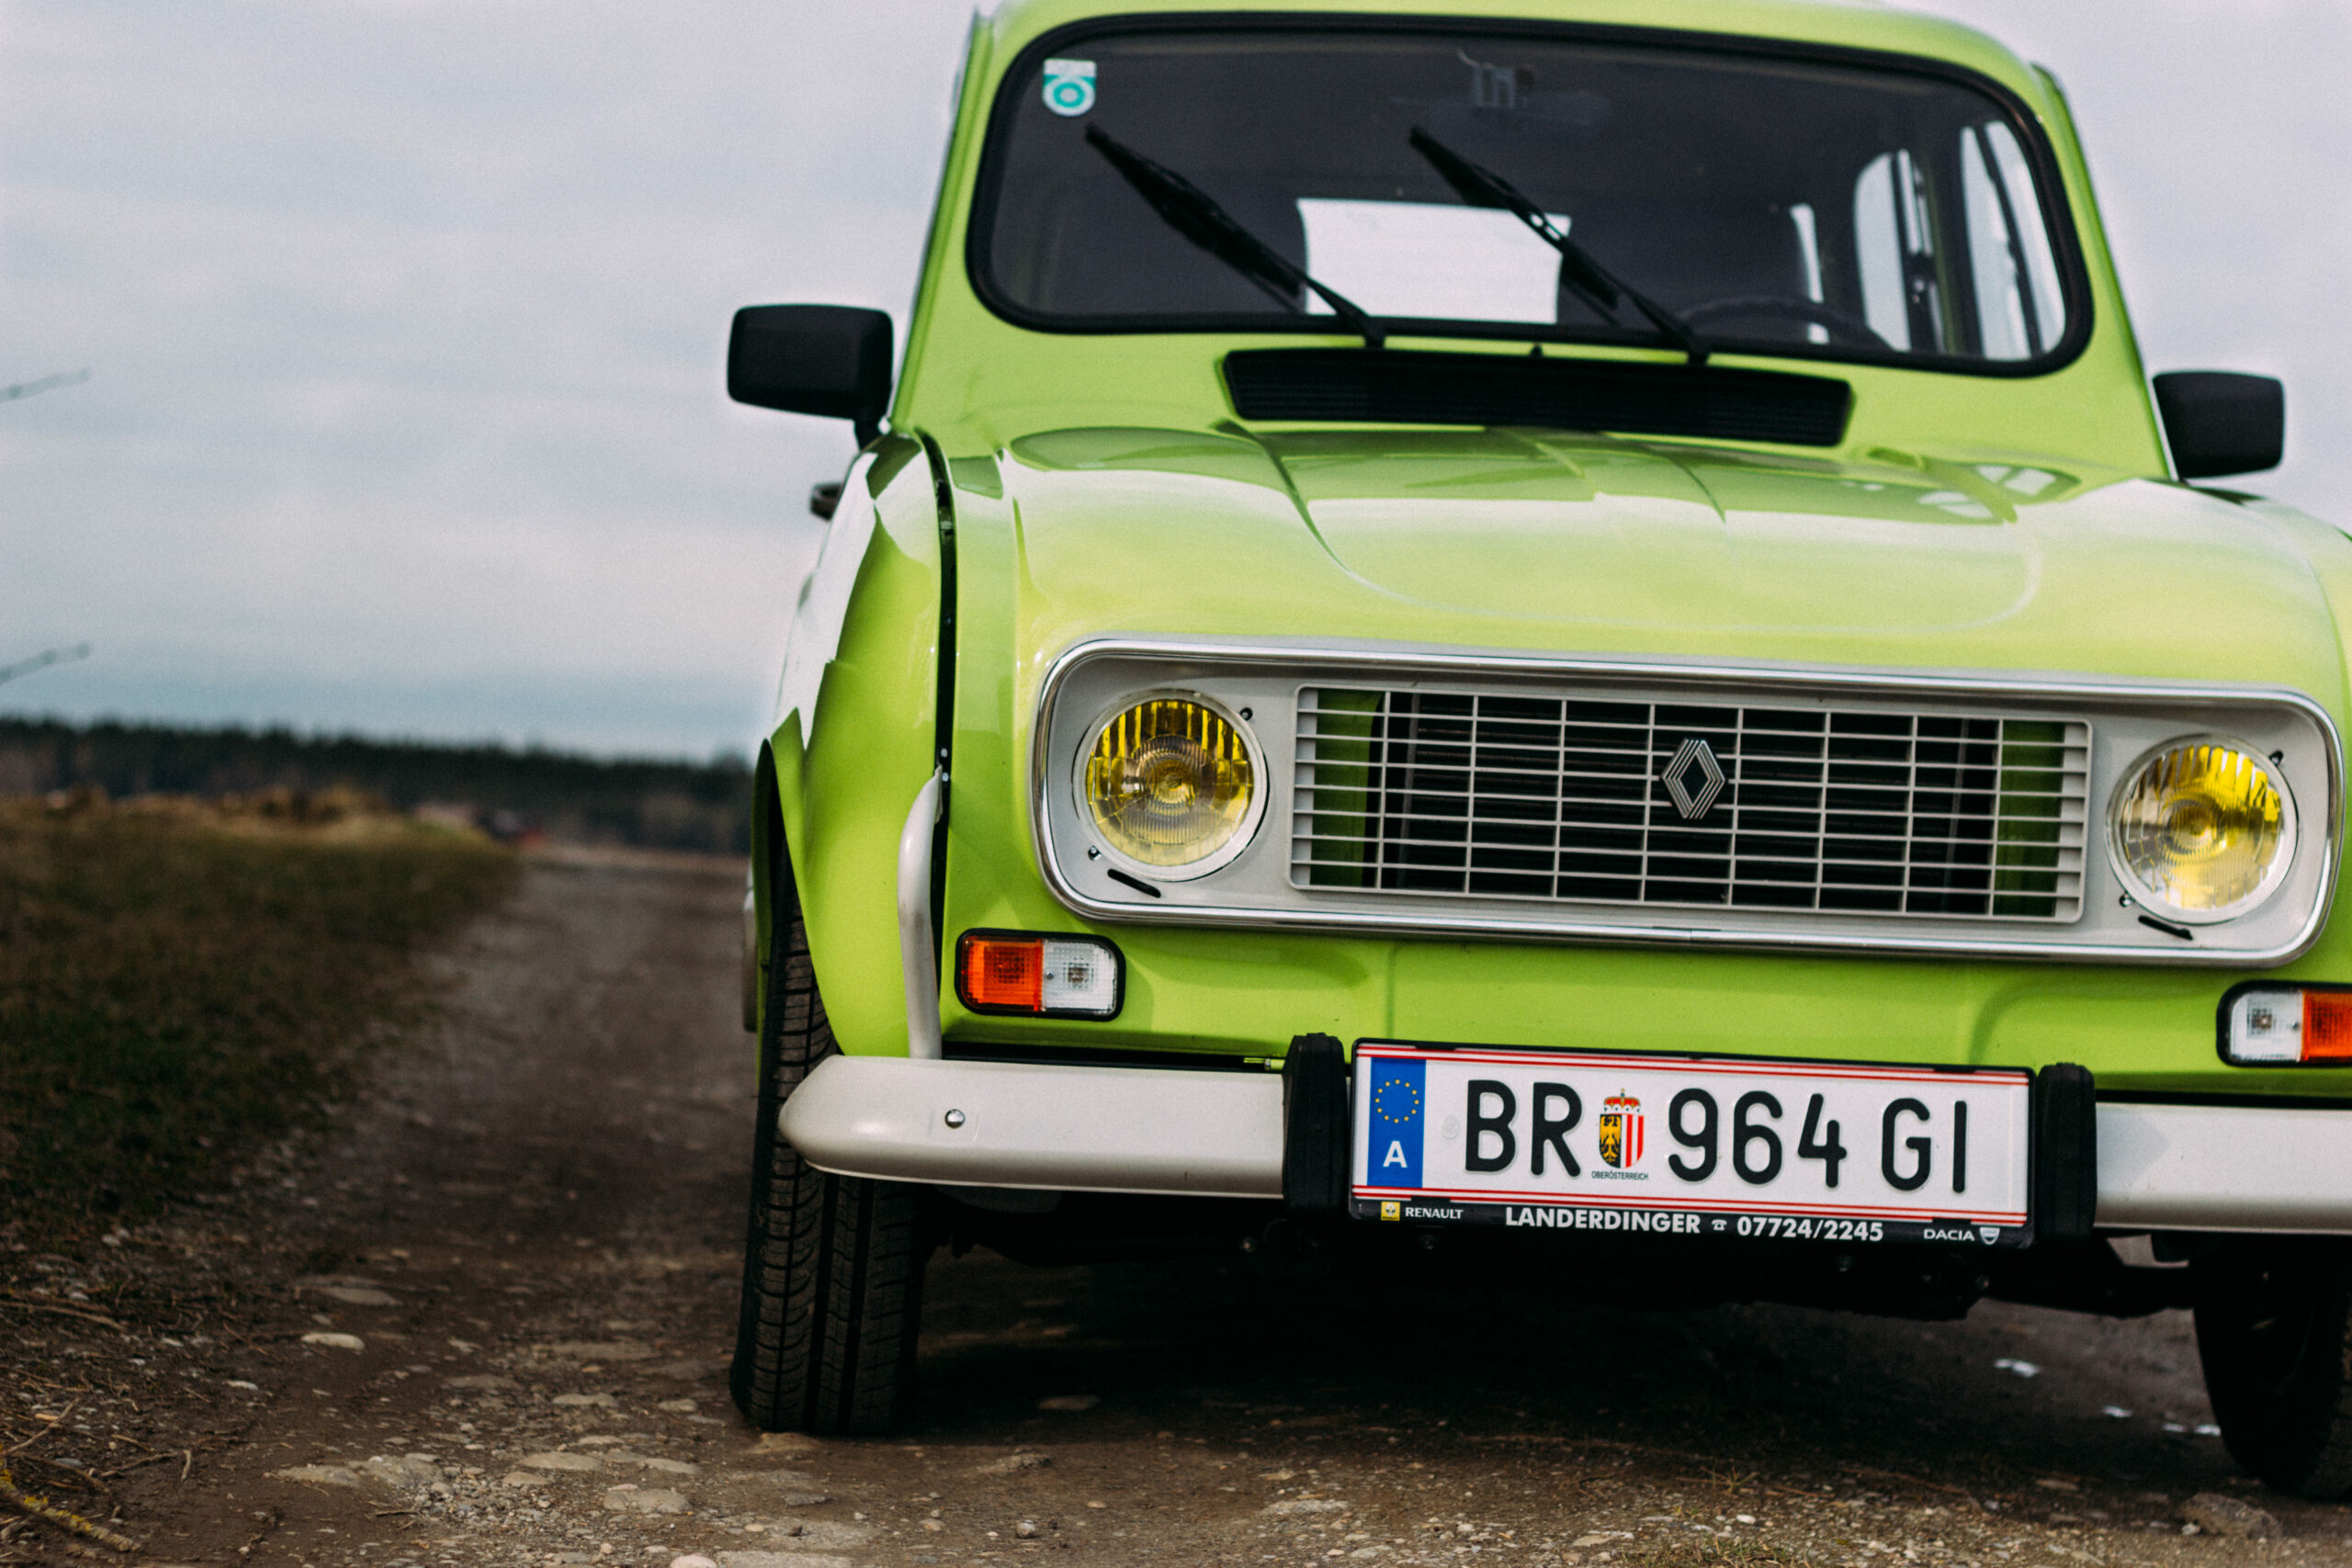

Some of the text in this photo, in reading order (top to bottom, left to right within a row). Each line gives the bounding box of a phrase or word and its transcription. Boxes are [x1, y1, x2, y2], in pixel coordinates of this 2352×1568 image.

[1465, 1079, 1968, 1193] BR 964 GI
[1383, 1140, 1408, 1168] A
[1591, 1169, 1648, 1180] OBERÖSTERREICH
[1406, 1206, 1464, 1220] RENAULT
[1505, 1206, 1884, 1242] LANDERDINGER 07724/2245
[1923, 1228, 1976, 1242] DACIA
